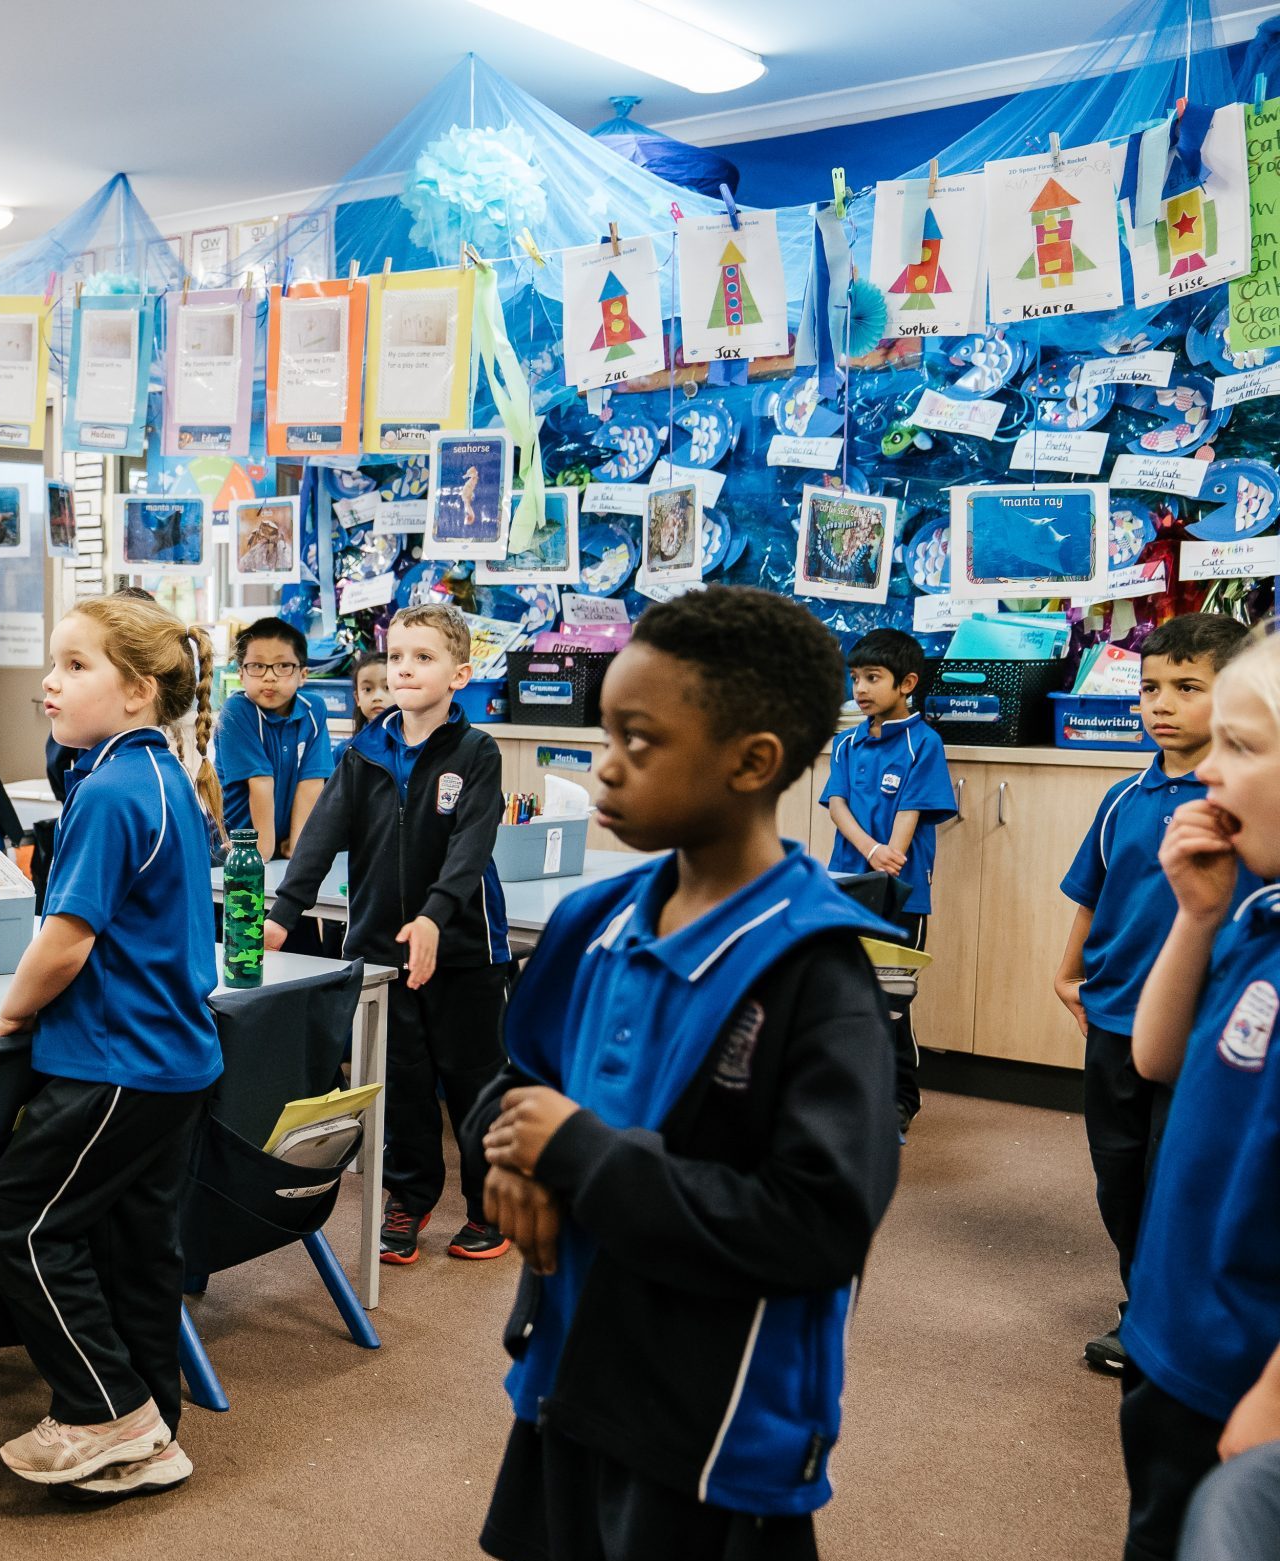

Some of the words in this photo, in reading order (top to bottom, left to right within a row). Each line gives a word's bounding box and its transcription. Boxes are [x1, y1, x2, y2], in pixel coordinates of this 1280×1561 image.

[1168, 275, 1206, 297] Elise
[1022, 302, 1074, 319] Kiara
[898, 322, 939, 338] Sophie
[714, 346, 742, 360] Jax
[604, 369, 629, 385] Zac
[307, 432, 322, 443] Lily
[397, 429, 426, 441] Darren
[453, 444, 490, 454] seahorse
[145, 504, 168, 512] manta
[169, 505, 185, 514] ray
[1003, 497, 1040, 507] manta
[1044, 498, 1063, 509] ray
[1211, 546, 1224, 556] My
[1227, 544, 1243, 554] fish
[529, 684, 561, 692] Grammar
[949, 698, 979, 709] Poetry
[951, 709, 977, 719] Books
[1069, 715, 1140, 730] Handwriting
[1085, 729, 1119, 740] Books
[554, 753, 579, 764] Maths
